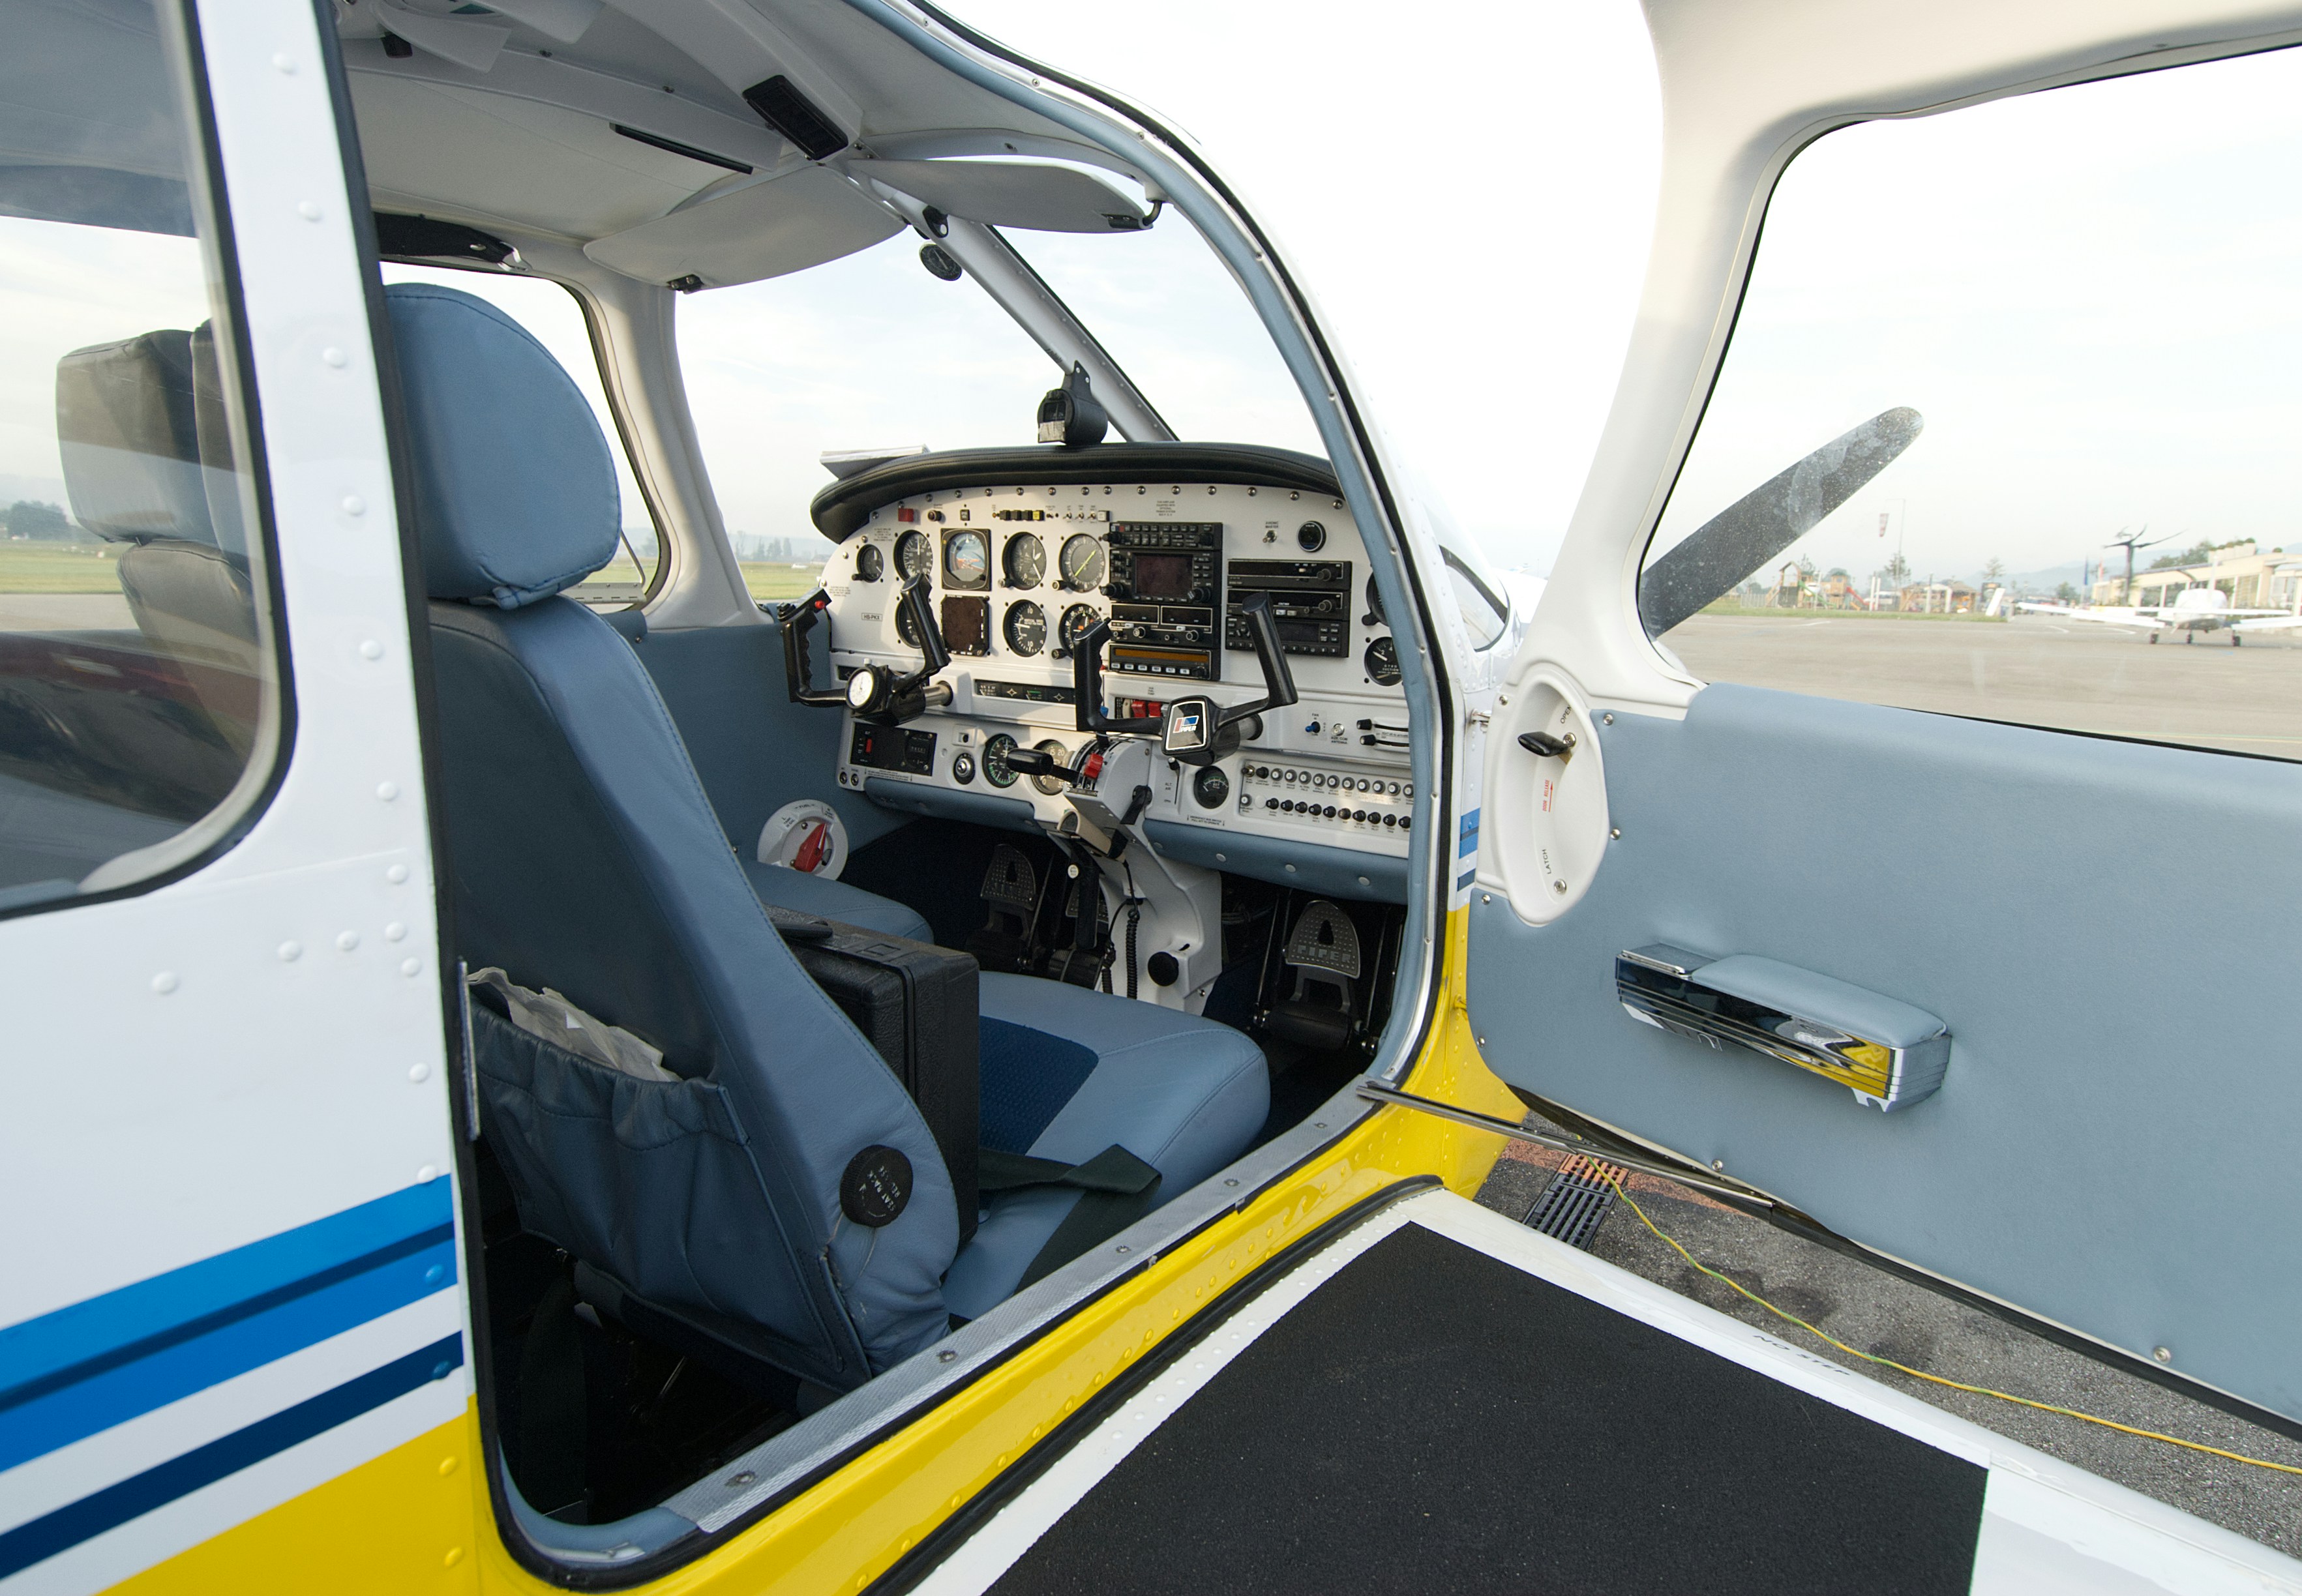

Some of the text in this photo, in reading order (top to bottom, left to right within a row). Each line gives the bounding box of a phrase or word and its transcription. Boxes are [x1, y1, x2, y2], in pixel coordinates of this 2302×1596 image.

[1560, 705, 1572, 724] OPEN
[1542, 849, 1551, 874] LATCH
[1297, 945, 1351, 963] PIPER
[1753, 1335, 1790, 1350] NO
